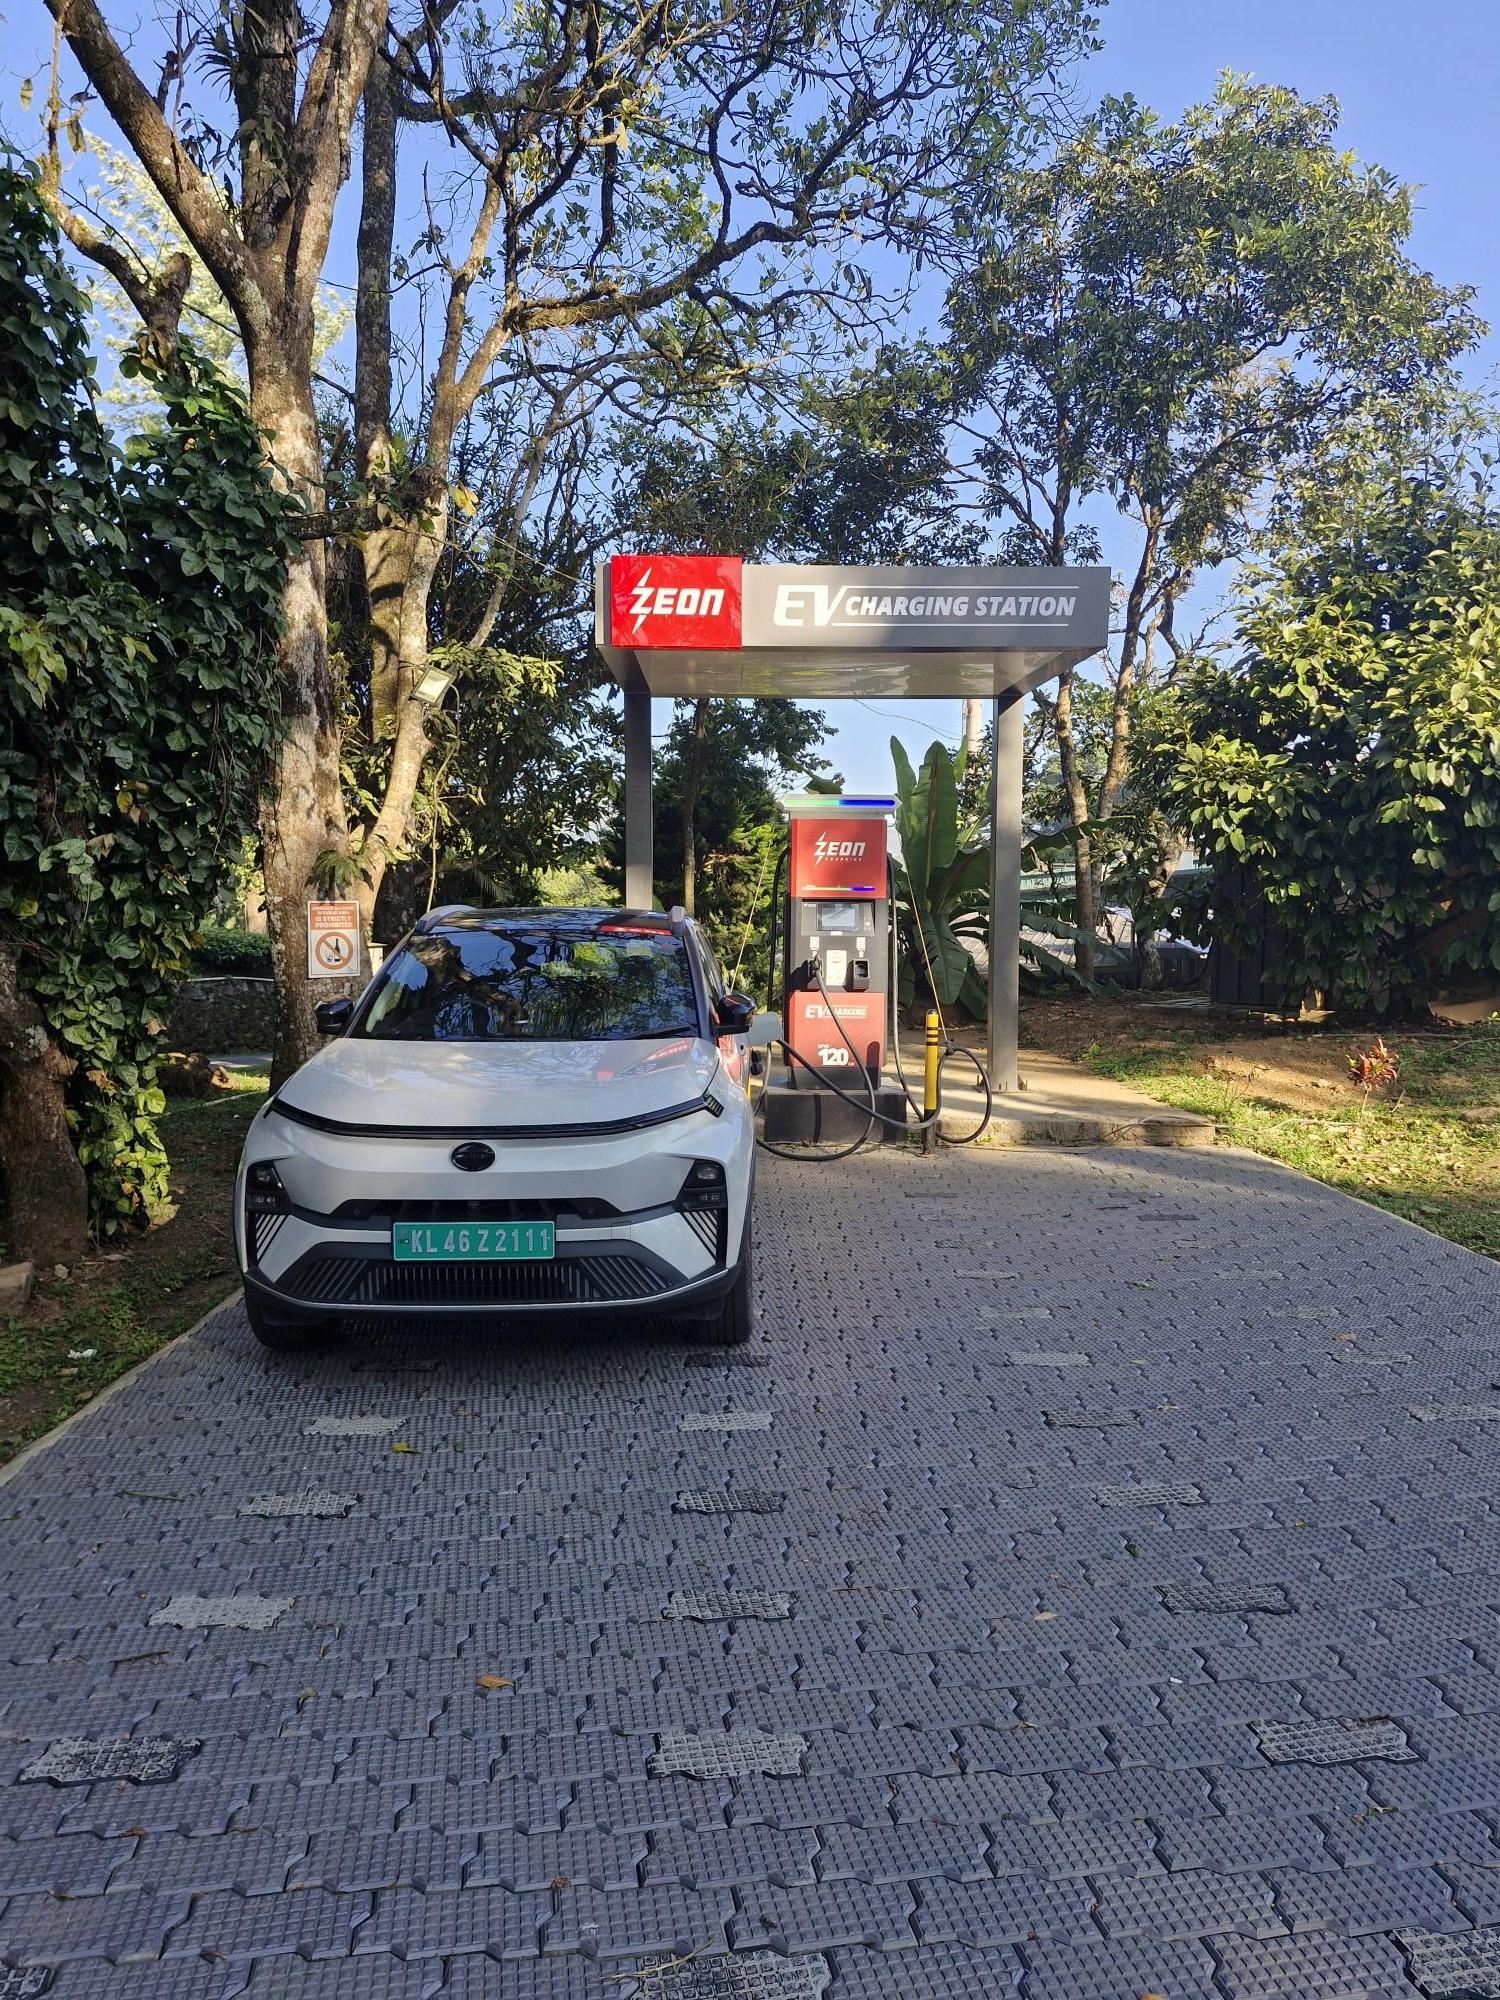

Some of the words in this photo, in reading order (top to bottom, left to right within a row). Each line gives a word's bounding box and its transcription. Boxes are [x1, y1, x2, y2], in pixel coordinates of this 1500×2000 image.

[773, 584, 848, 627] EV
[845, 596, 969, 616] CHARGING
[974, 596, 1076, 617] STATION
[805, 1005, 828, 1018] EV
[818, 1048, 849, 1066] 120
